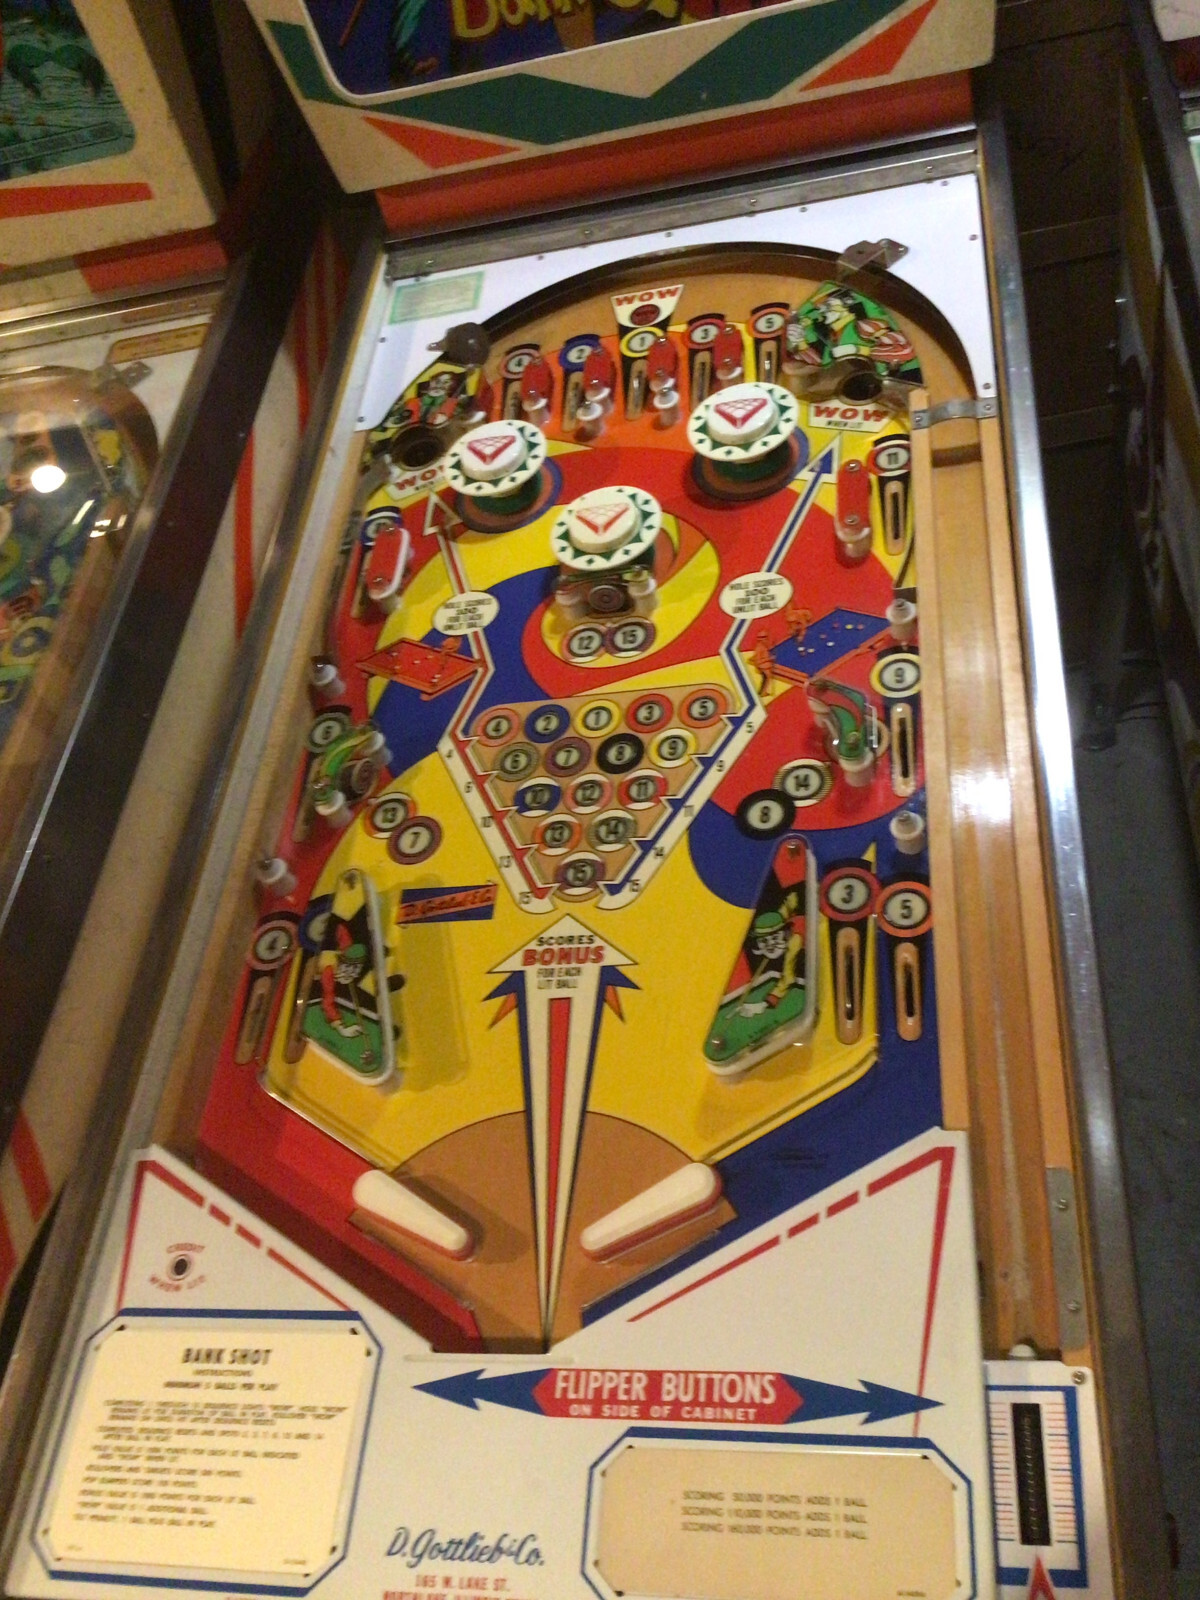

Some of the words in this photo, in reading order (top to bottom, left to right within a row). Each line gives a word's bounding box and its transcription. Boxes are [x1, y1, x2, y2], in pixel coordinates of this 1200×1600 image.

[615, 287, 679, 306] WOW
[765, 318, 774, 329] 5
[701, 328, 710, 340] 3
[576, 348, 585, 360] 2
[514, 358, 524, 368] 4
[814, 406, 888, 422] WOW
[887, 452, 899, 465] 11
[753, 578, 783, 587] SCORES
[578, 635, 595, 650] 12
[622, 630, 637, 644] 15
[894, 667, 905, 684] 9
[643, 705, 654, 721] 3
[700, 700, 708, 716] 5
[491, 720, 501, 732] 4
[543, 714, 551, 730] 2
[595, 711, 600, 726] 1
[746, 722, 754, 733] 5
[615, 745, 624, 761] 8
[668, 740, 678, 756] 9
[564, 750, 573, 765] 7
[637, 781, 649, 799] 11
[794, 774, 810, 790] 14
[583, 784, 597, 802] 12
[759, 806, 770, 823] 8
[605, 820, 622, 839] 14
[410, 832, 421, 848] 7
[841, 885, 854, 904] 3
[900, 900, 912, 919] 5
[536, 935, 595, 946] SCORES
[522, 946, 604, 967] BONUS
[537, 968, 554, 977] FOR
[557, 967, 580, 977] EACH
[556, 979, 578, 988] BALL
[182, 1348, 225, 1364] BANK
[228, 1349, 272, 1365] SHOT
[555, 1370, 647, 1401] FLIPPER
[661, 1373, 776, 1404] BUTTONS
[569, 1404, 592, 1416] ON
[601, 1405, 640, 1417] SIDE
[650, 1406, 672, 1418] OF
[681, 1407, 756, 1421] CABINET
[683, 1491, 723, 1501] SCORING
[766, 1494, 800, 1504] POINTS
[843, 1498, 867, 1507] BALL
[682, 1506, 723, 1516] SCORING
[843, 1514, 867, 1523] BALL
[681, 1522, 723, 1532] SCORING
[843, 1530, 867, 1540] BALL
